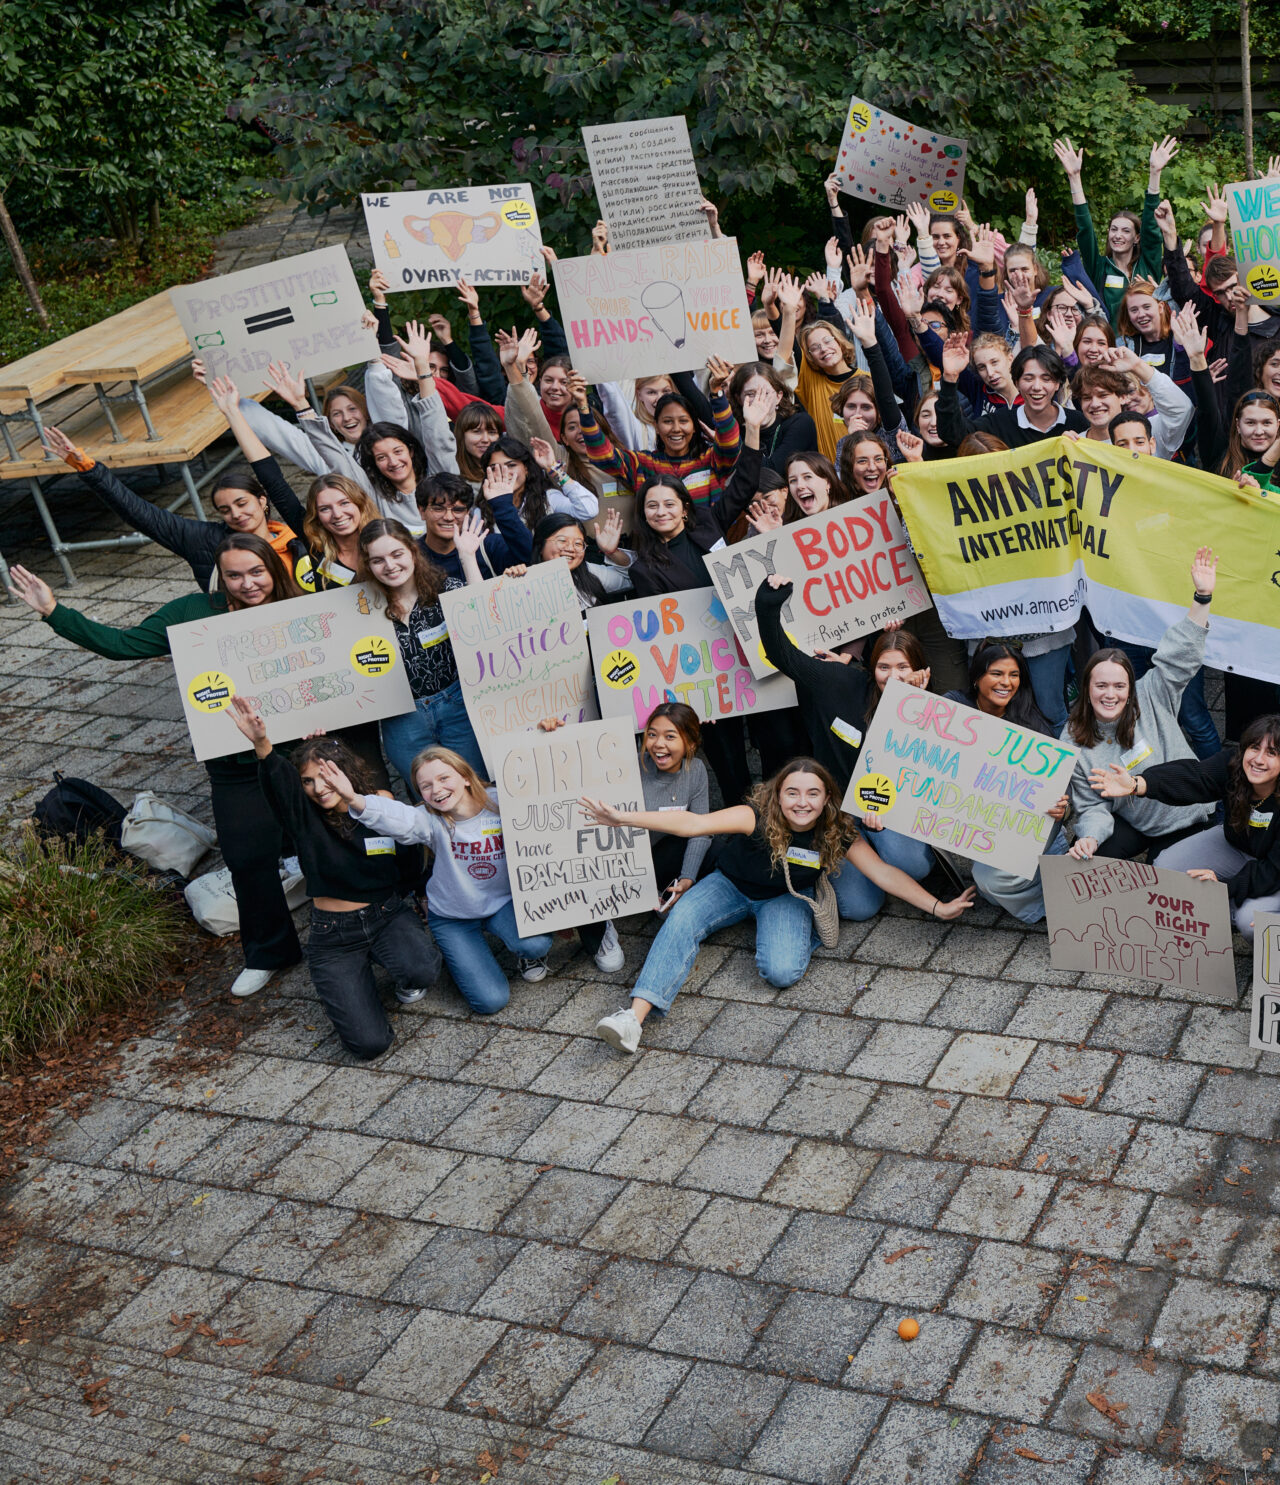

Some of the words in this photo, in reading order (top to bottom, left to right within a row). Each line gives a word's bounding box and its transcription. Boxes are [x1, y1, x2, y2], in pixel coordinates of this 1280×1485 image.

[367, 196, 390, 208] WE
[427, 191, 469, 205] ARE
[488, 187, 522, 199] NOT
[587, 297, 631, 317] YOUR
[688, 286, 734, 308] YOUR
[288, 320, 365, 360] RAPE
[571, 316, 654, 349] HANDS
[946, 455, 1124, 527] AMNESTY
[712, 539, 777, 600] MY
[792, 500, 893, 571] BODY
[803, 544, 914, 617] CHOICE
[452, 569, 576, 646] CLIMATE
[607, 598, 685, 647] OUR
[806, 620, 850, 646] #Right
[854, 616, 865, 627] to
[870, 600, 907, 628] protest
[217, 611, 337, 667] PROTEST
[464, 622, 580, 687] Justice
[243, 668, 355, 717] PROGRESS
[479, 673, 590, 738] RACIAL
[897, 694, 982, 746] GIRLS
[988, 727, 1075, 778] JUST
[885, 729, 960, 779] WANNA
[973, 763, 1044, 809] HAVE
[512, 799, 578, 831] JUST
[896, 767, 1048, 843] FUNDAMENTAL
[516, 841, 553, 857] have
[911, 807, 996, 853] RIGHTS
[517, 852, 647, 892] DAMENTAL
[1065, 860, 1158, 904] DEFEND
[524, 887, 588, 924] human
[589, 879, 643, 920] rights
[1147, 891, 1195, 917] YOUR
